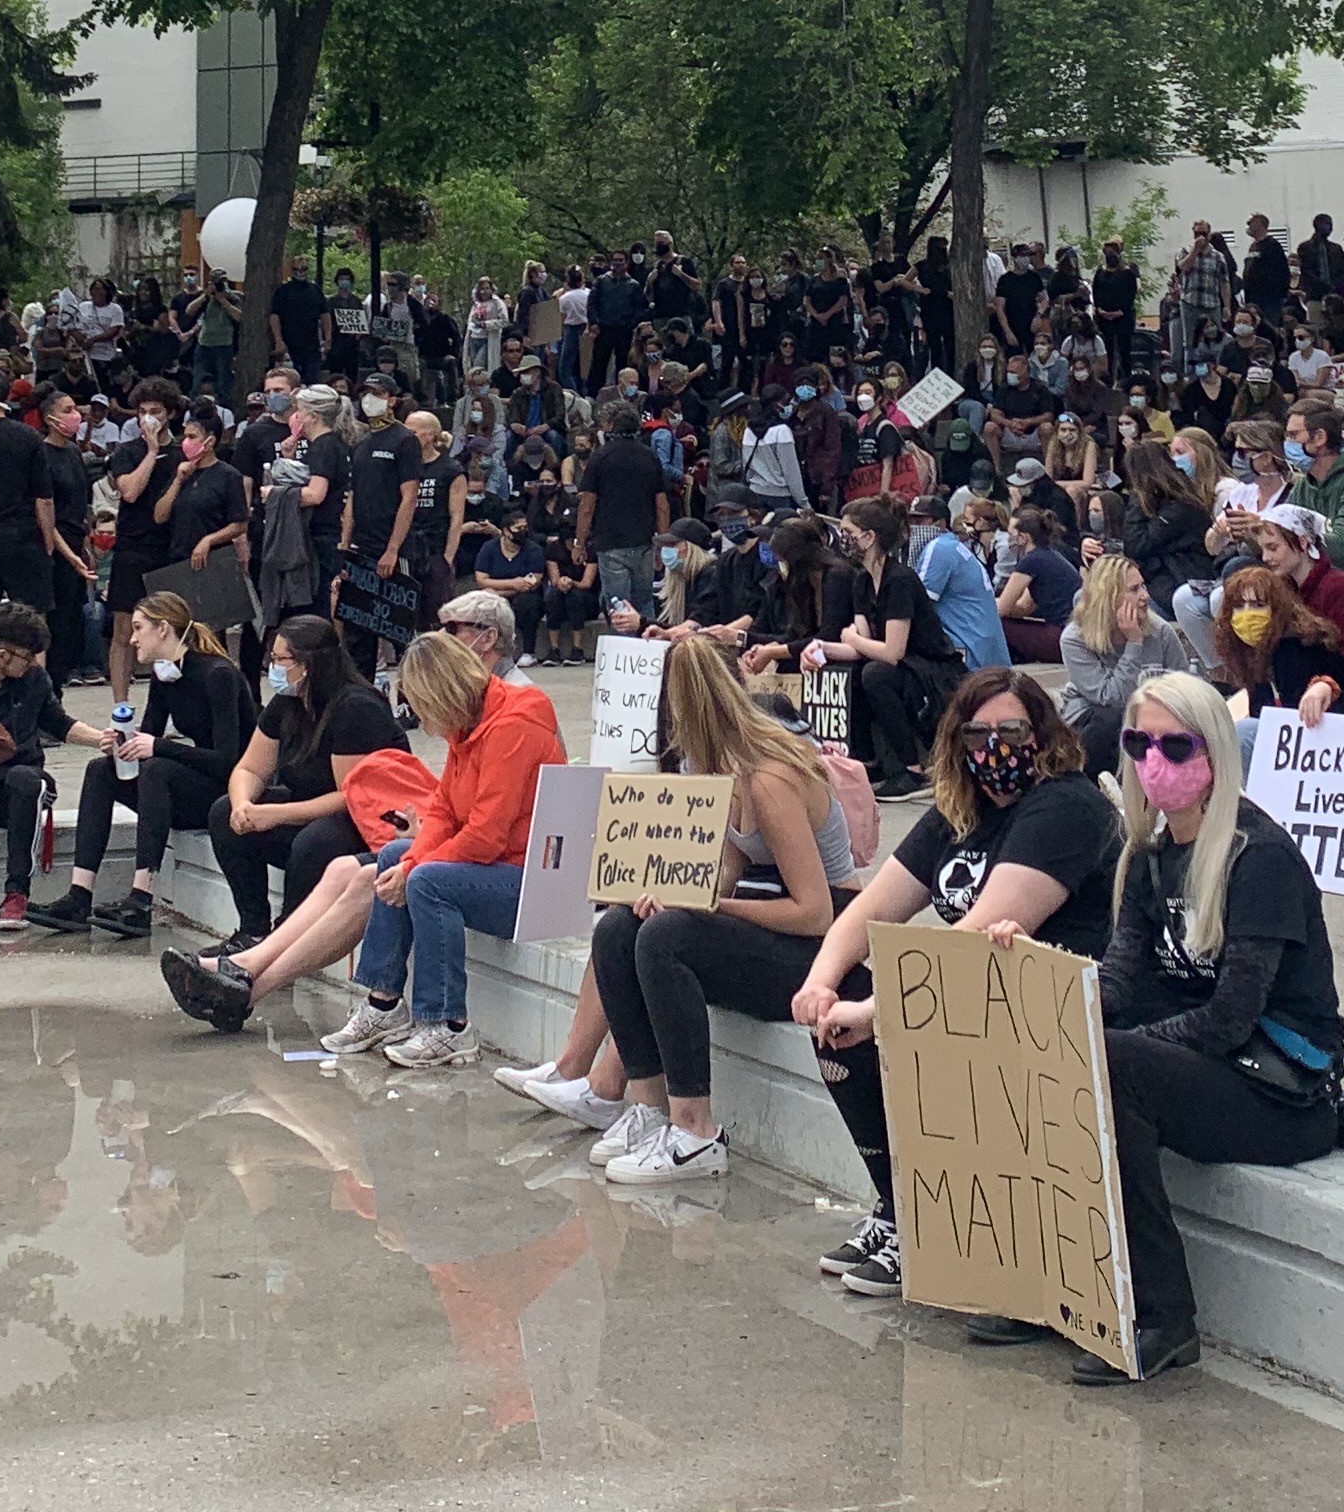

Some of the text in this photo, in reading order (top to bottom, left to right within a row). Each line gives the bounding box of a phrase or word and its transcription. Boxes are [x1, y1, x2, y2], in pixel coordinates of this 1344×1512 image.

[622, 692, 658, 711] UNTIL
[803, 669, 848, 707] BLACK
[807, 705, 848, 739] LIVES
[608, 784, 716, 817] Who do you
[606, 818, 716, 845] Call when the
[597, 851, 637, 892] Police
[897, 949, 1088, 1068] BLACK
[913, 1049, 1105, 1186] LIVES
[912, 1168, 1119, 1311] MATTER
